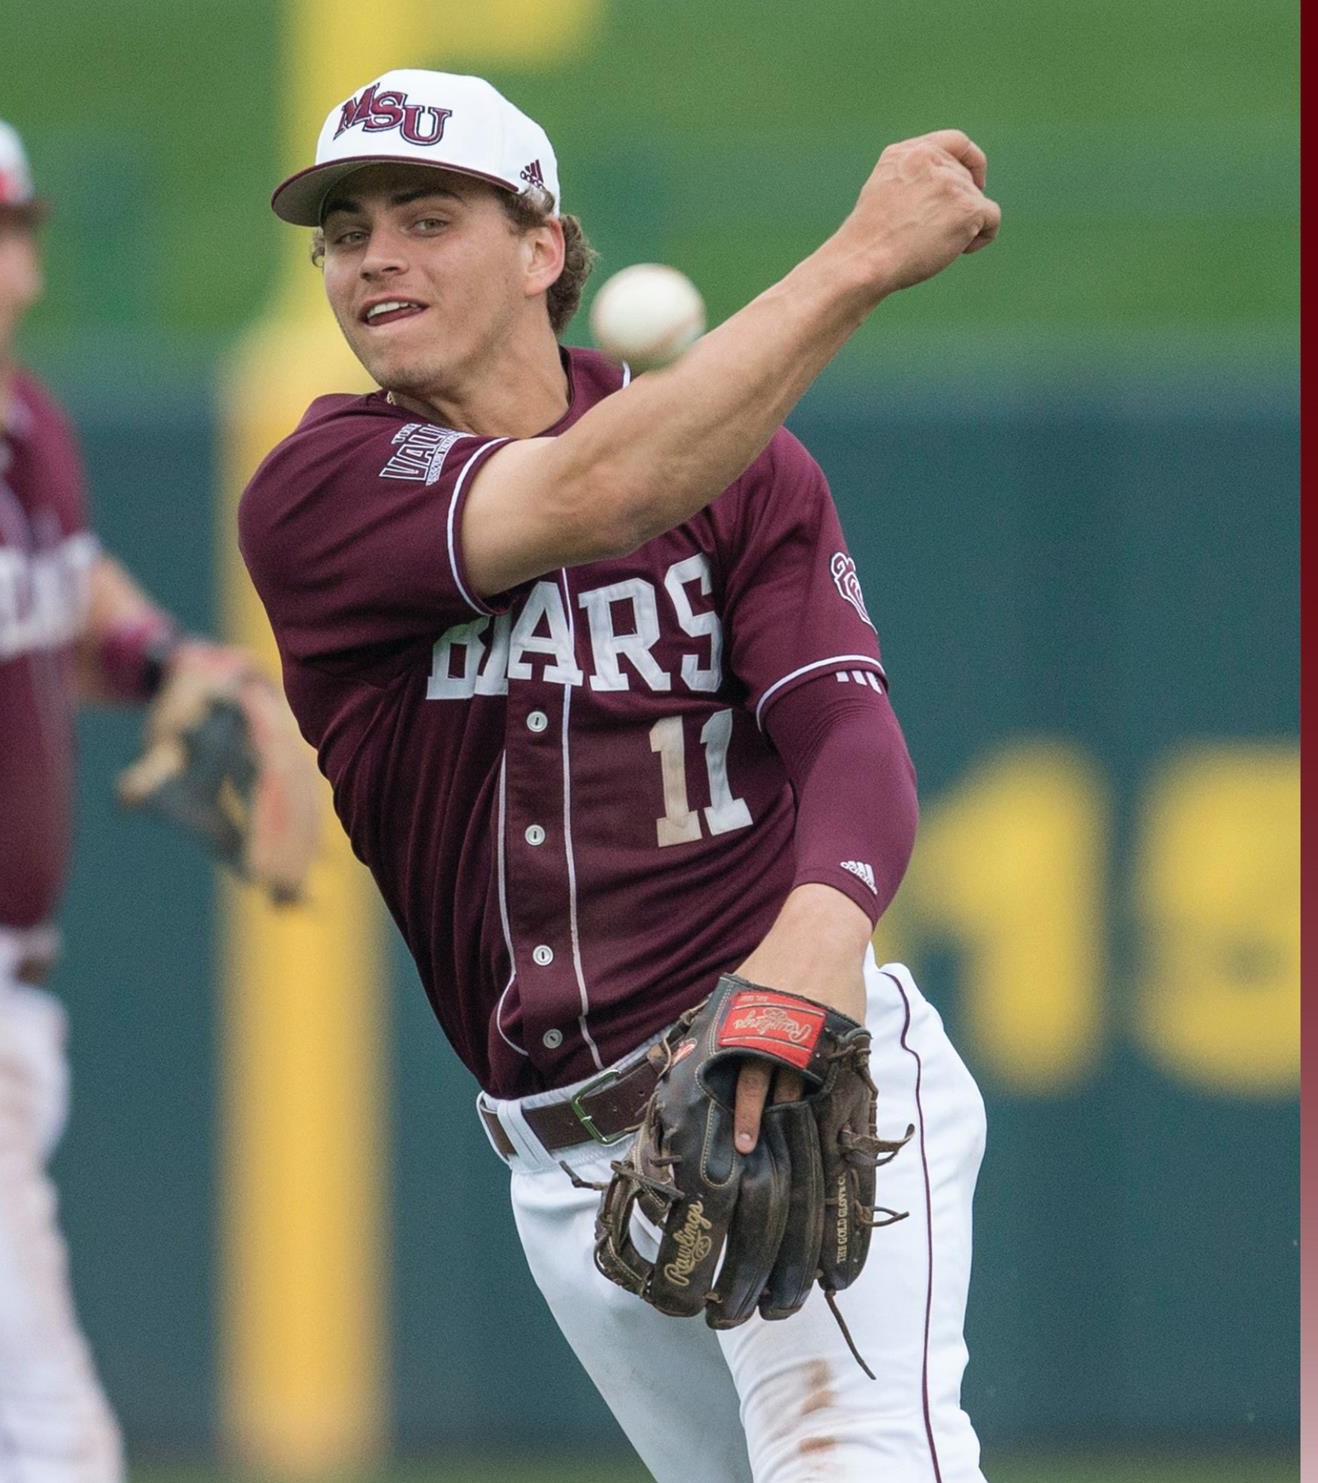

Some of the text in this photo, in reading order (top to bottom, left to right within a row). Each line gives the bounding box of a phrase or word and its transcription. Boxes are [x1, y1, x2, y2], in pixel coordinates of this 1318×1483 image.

[332, 81, 453, 147] MSU
[648, 708, 754, 848] 11
[732, 1008, 813, 1043] Rawlings
[663, 1200, 713, 1287] Rawlings
[836, 1245, 848, 1265] THE
[837, 1218, 849, 1245] GOLD
